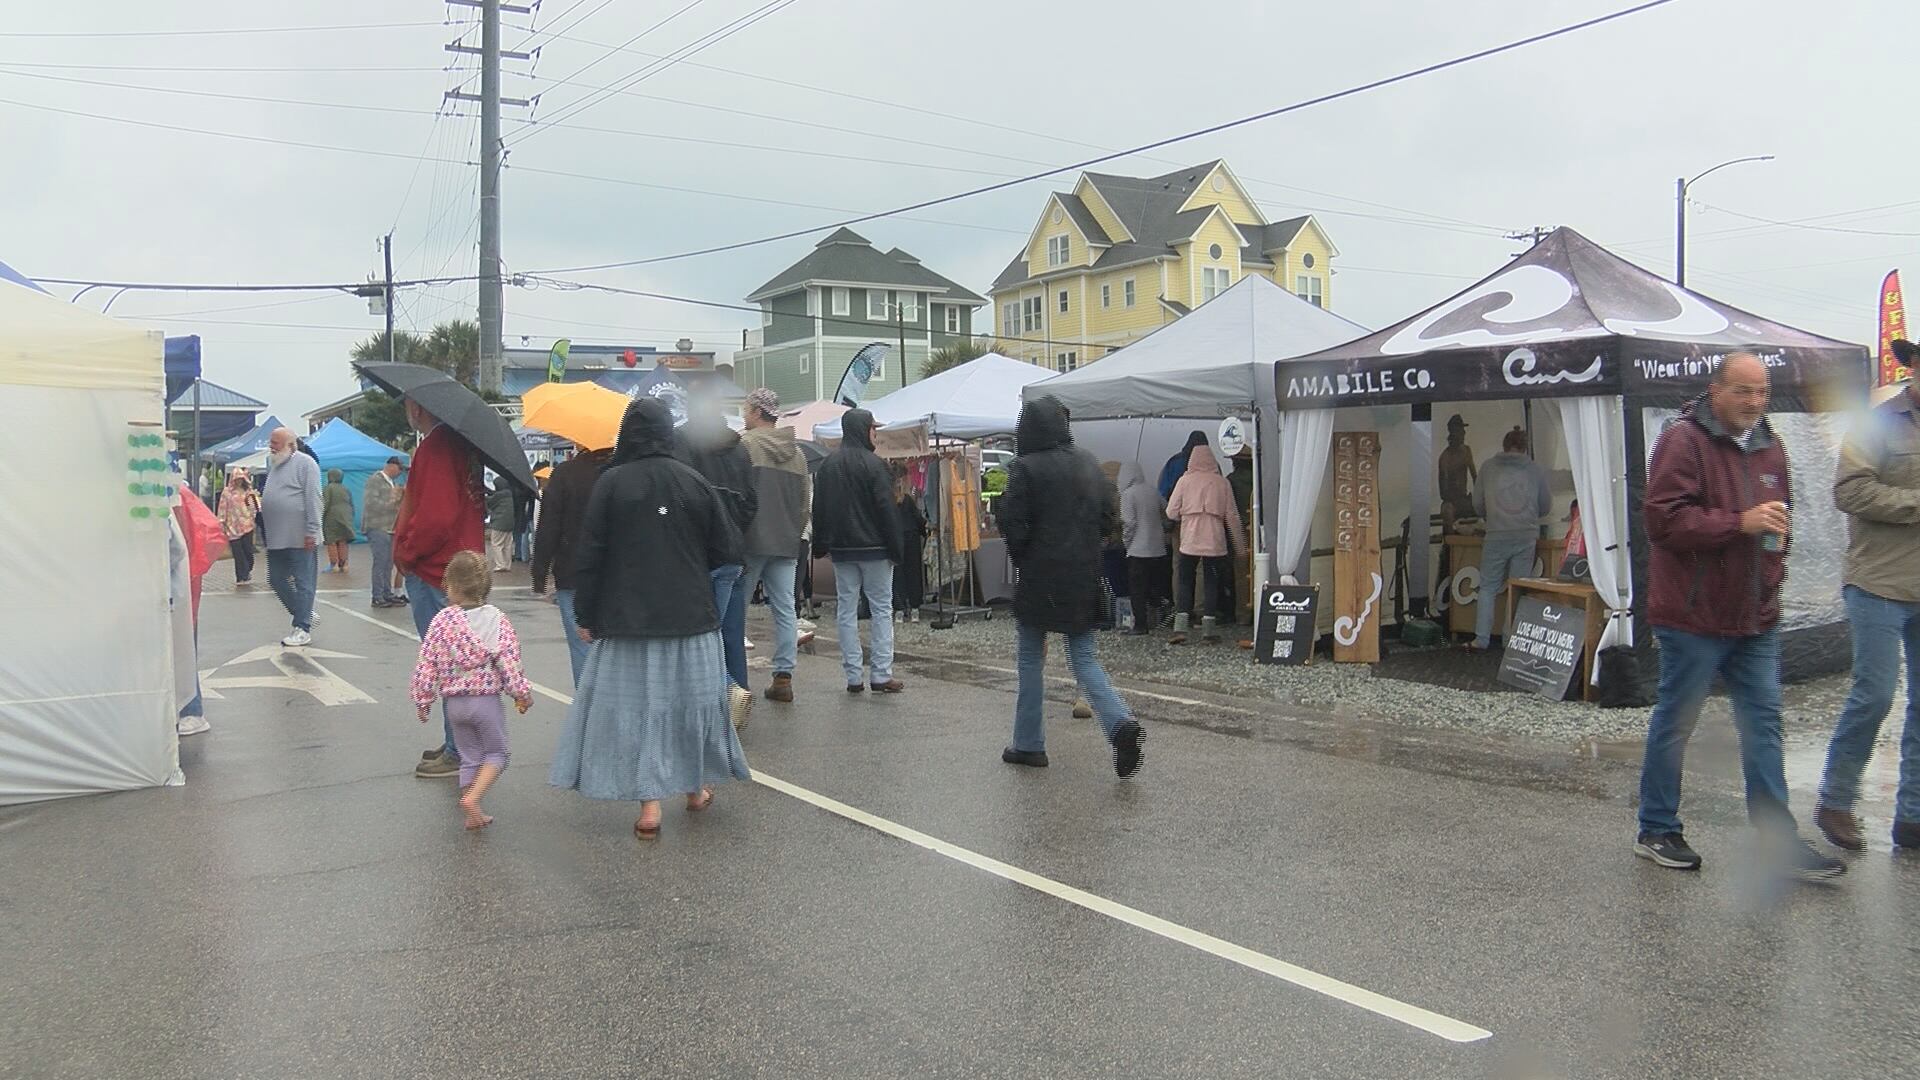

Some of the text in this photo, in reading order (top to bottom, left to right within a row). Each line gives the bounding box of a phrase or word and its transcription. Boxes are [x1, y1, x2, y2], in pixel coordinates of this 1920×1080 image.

[1683, 356, 1702, 376] for
[1287, 368, 1435, 398] AMABILE CO.
